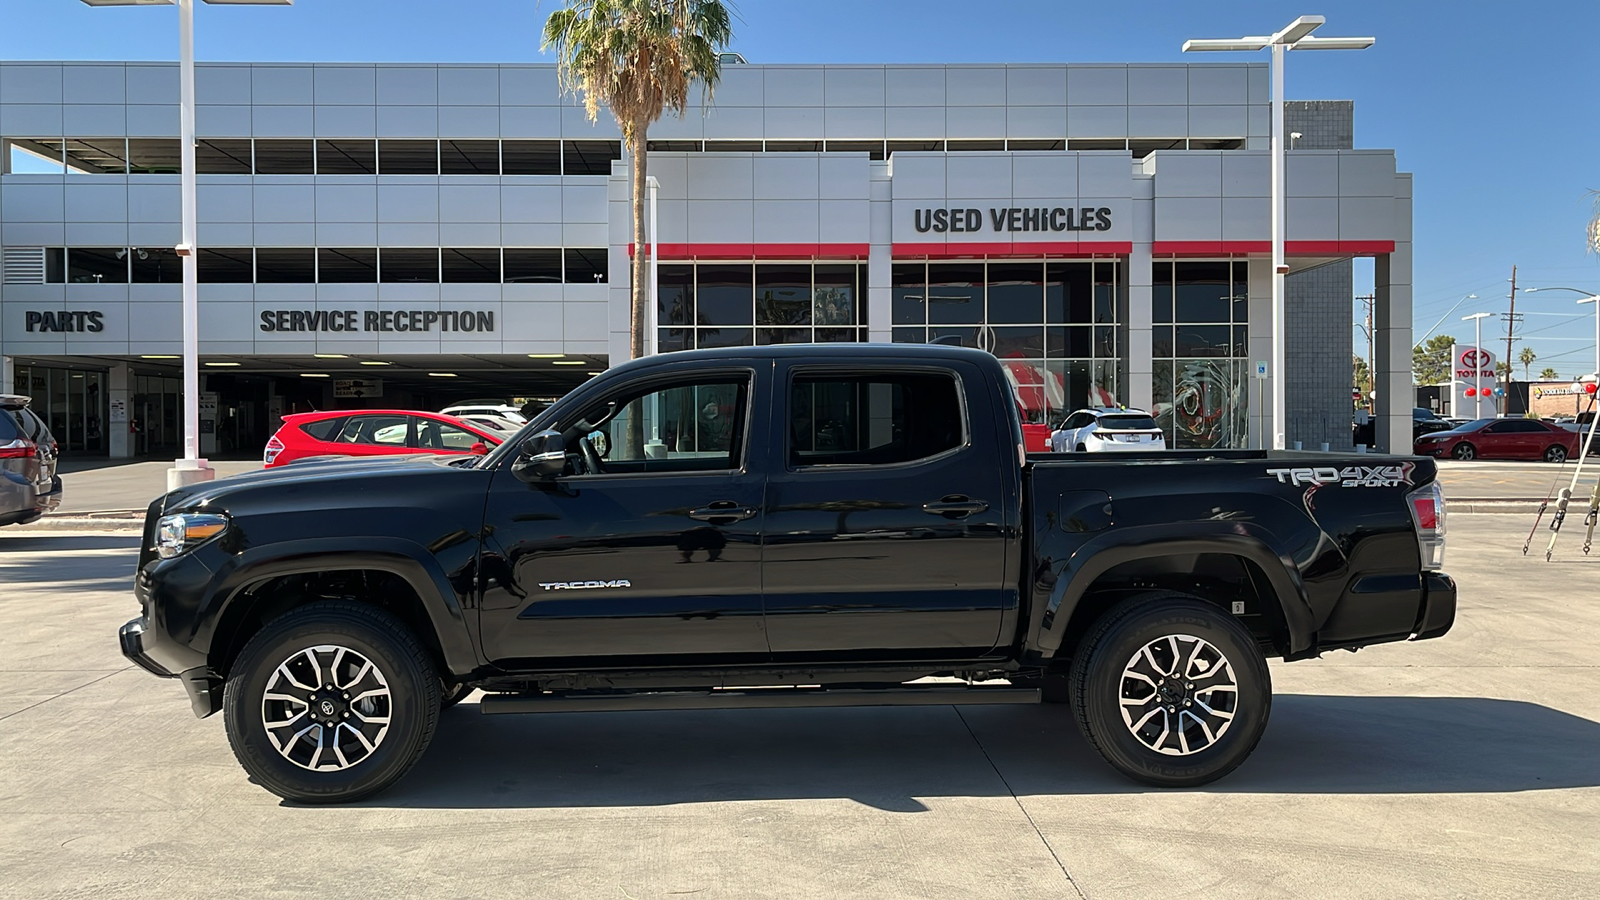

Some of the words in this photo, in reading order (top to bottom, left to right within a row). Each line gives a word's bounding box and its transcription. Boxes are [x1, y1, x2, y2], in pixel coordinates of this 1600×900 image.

[915, 208, 983, 233] USED
[990, 207, 1112, 232] VEHICLES
[25, 310, 104, 333] PARTS
[260, 310, 358, 332] SERVICE
[364, 310, 494, 332] RECEPTION
[1266, 467, 1341, 487] TRD
[1340, 466, 1404, 480] 4X4
[1341, 479, 1400, 488] SPORT
[538, 579, 631, 591] TACOMA
